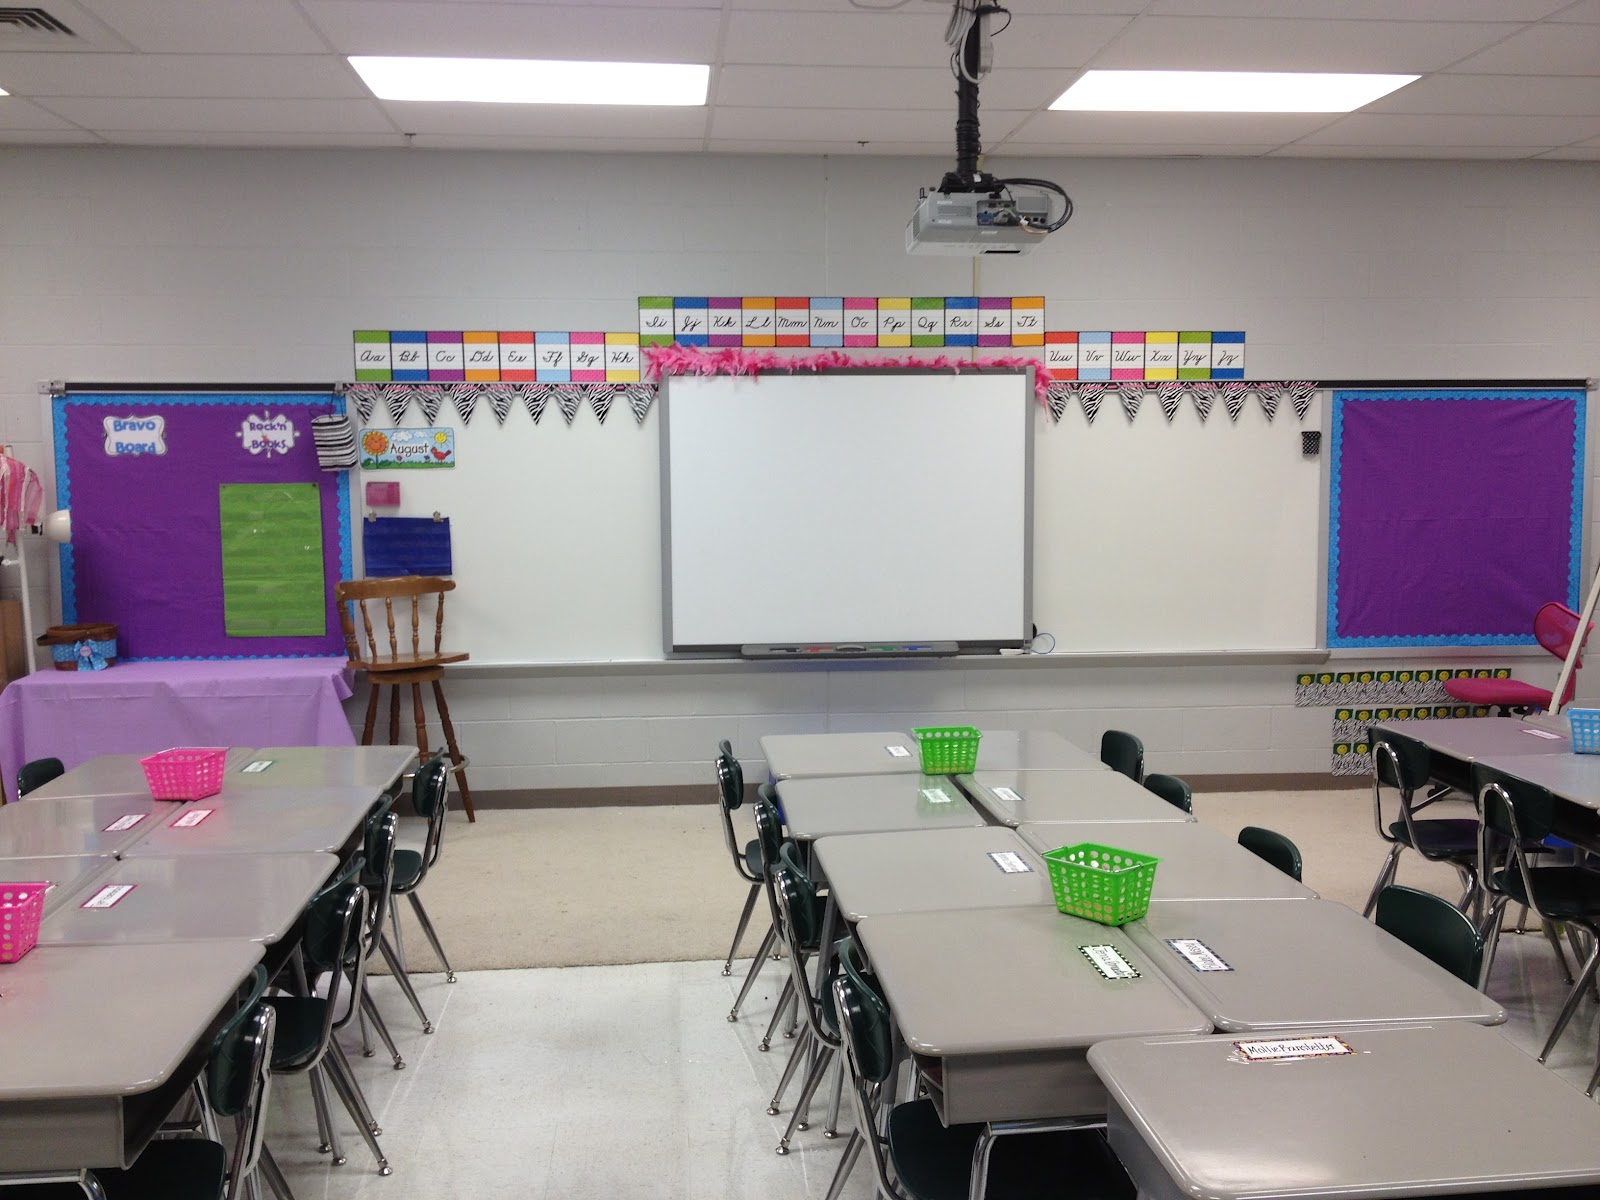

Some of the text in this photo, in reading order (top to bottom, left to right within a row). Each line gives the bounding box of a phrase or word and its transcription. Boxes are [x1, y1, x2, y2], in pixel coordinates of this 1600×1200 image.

[646, 316, 1037, 332] Ii Jj Kk Ll Mm Nn Oo Pp Qq Rr Ss Tt
[360, 350, 634, 367] Aa Bb Cc Dd Ee Ff Gg Hh
[1050, 350, 1239, 366] Uu Vv Ww Xx Yy Zz
[113, 419, 156, 432] Bravo
[115, 441, 156, 454] Board
[252, 439, 286, 449] Books
[389, 442, 429, 457] August
